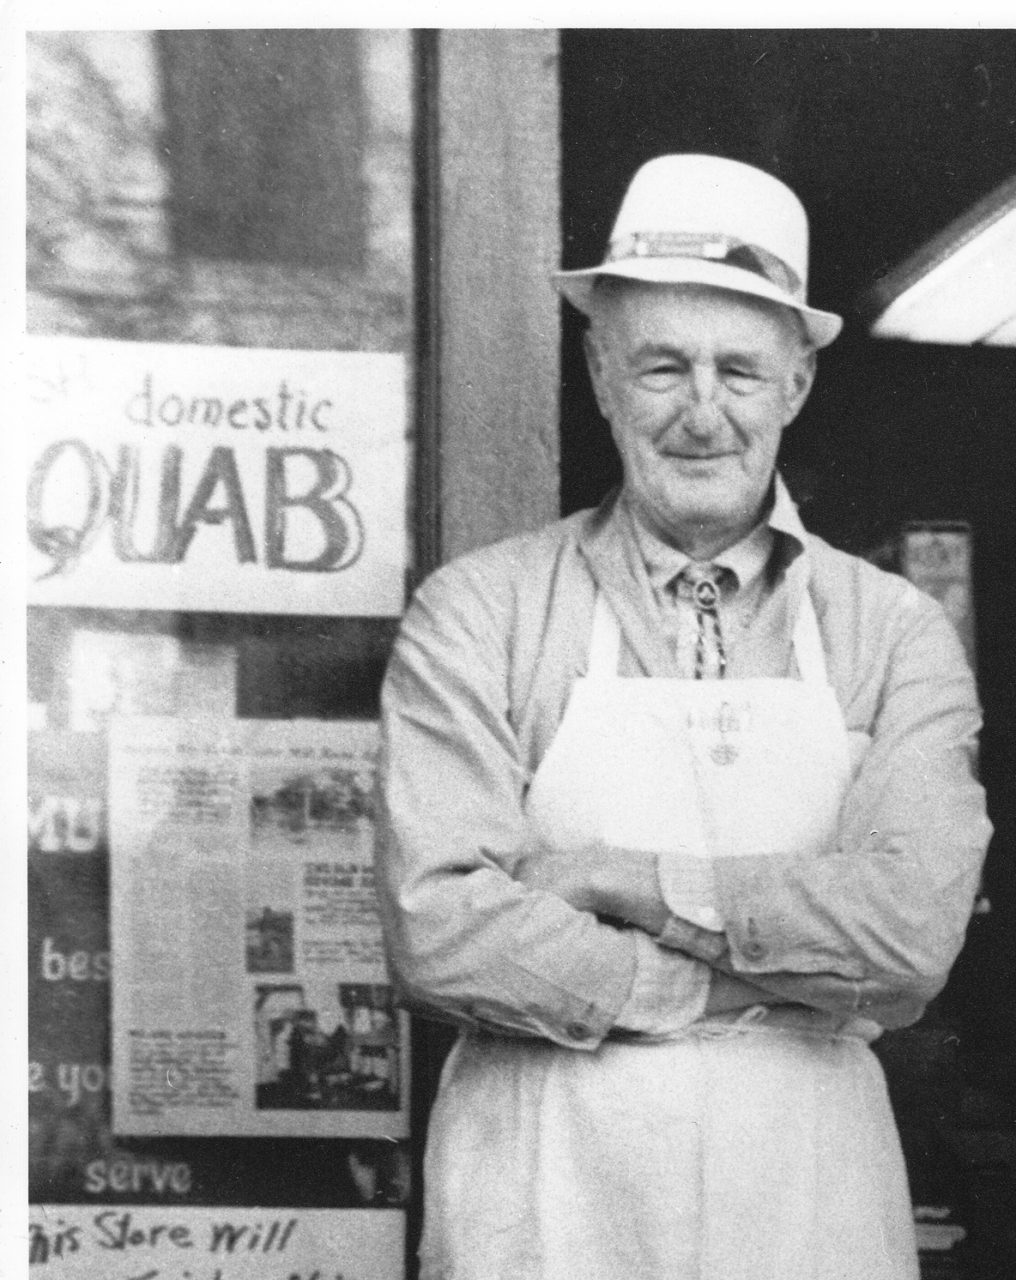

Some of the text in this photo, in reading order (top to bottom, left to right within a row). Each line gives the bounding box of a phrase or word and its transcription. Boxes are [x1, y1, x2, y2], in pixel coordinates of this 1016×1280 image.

[125, 373, 333, 432] domestic
[27, 438, 364, 582] QUAB
[85, 1158, 193, 1193] serve
[94, 1211, 194, 1250] Store
